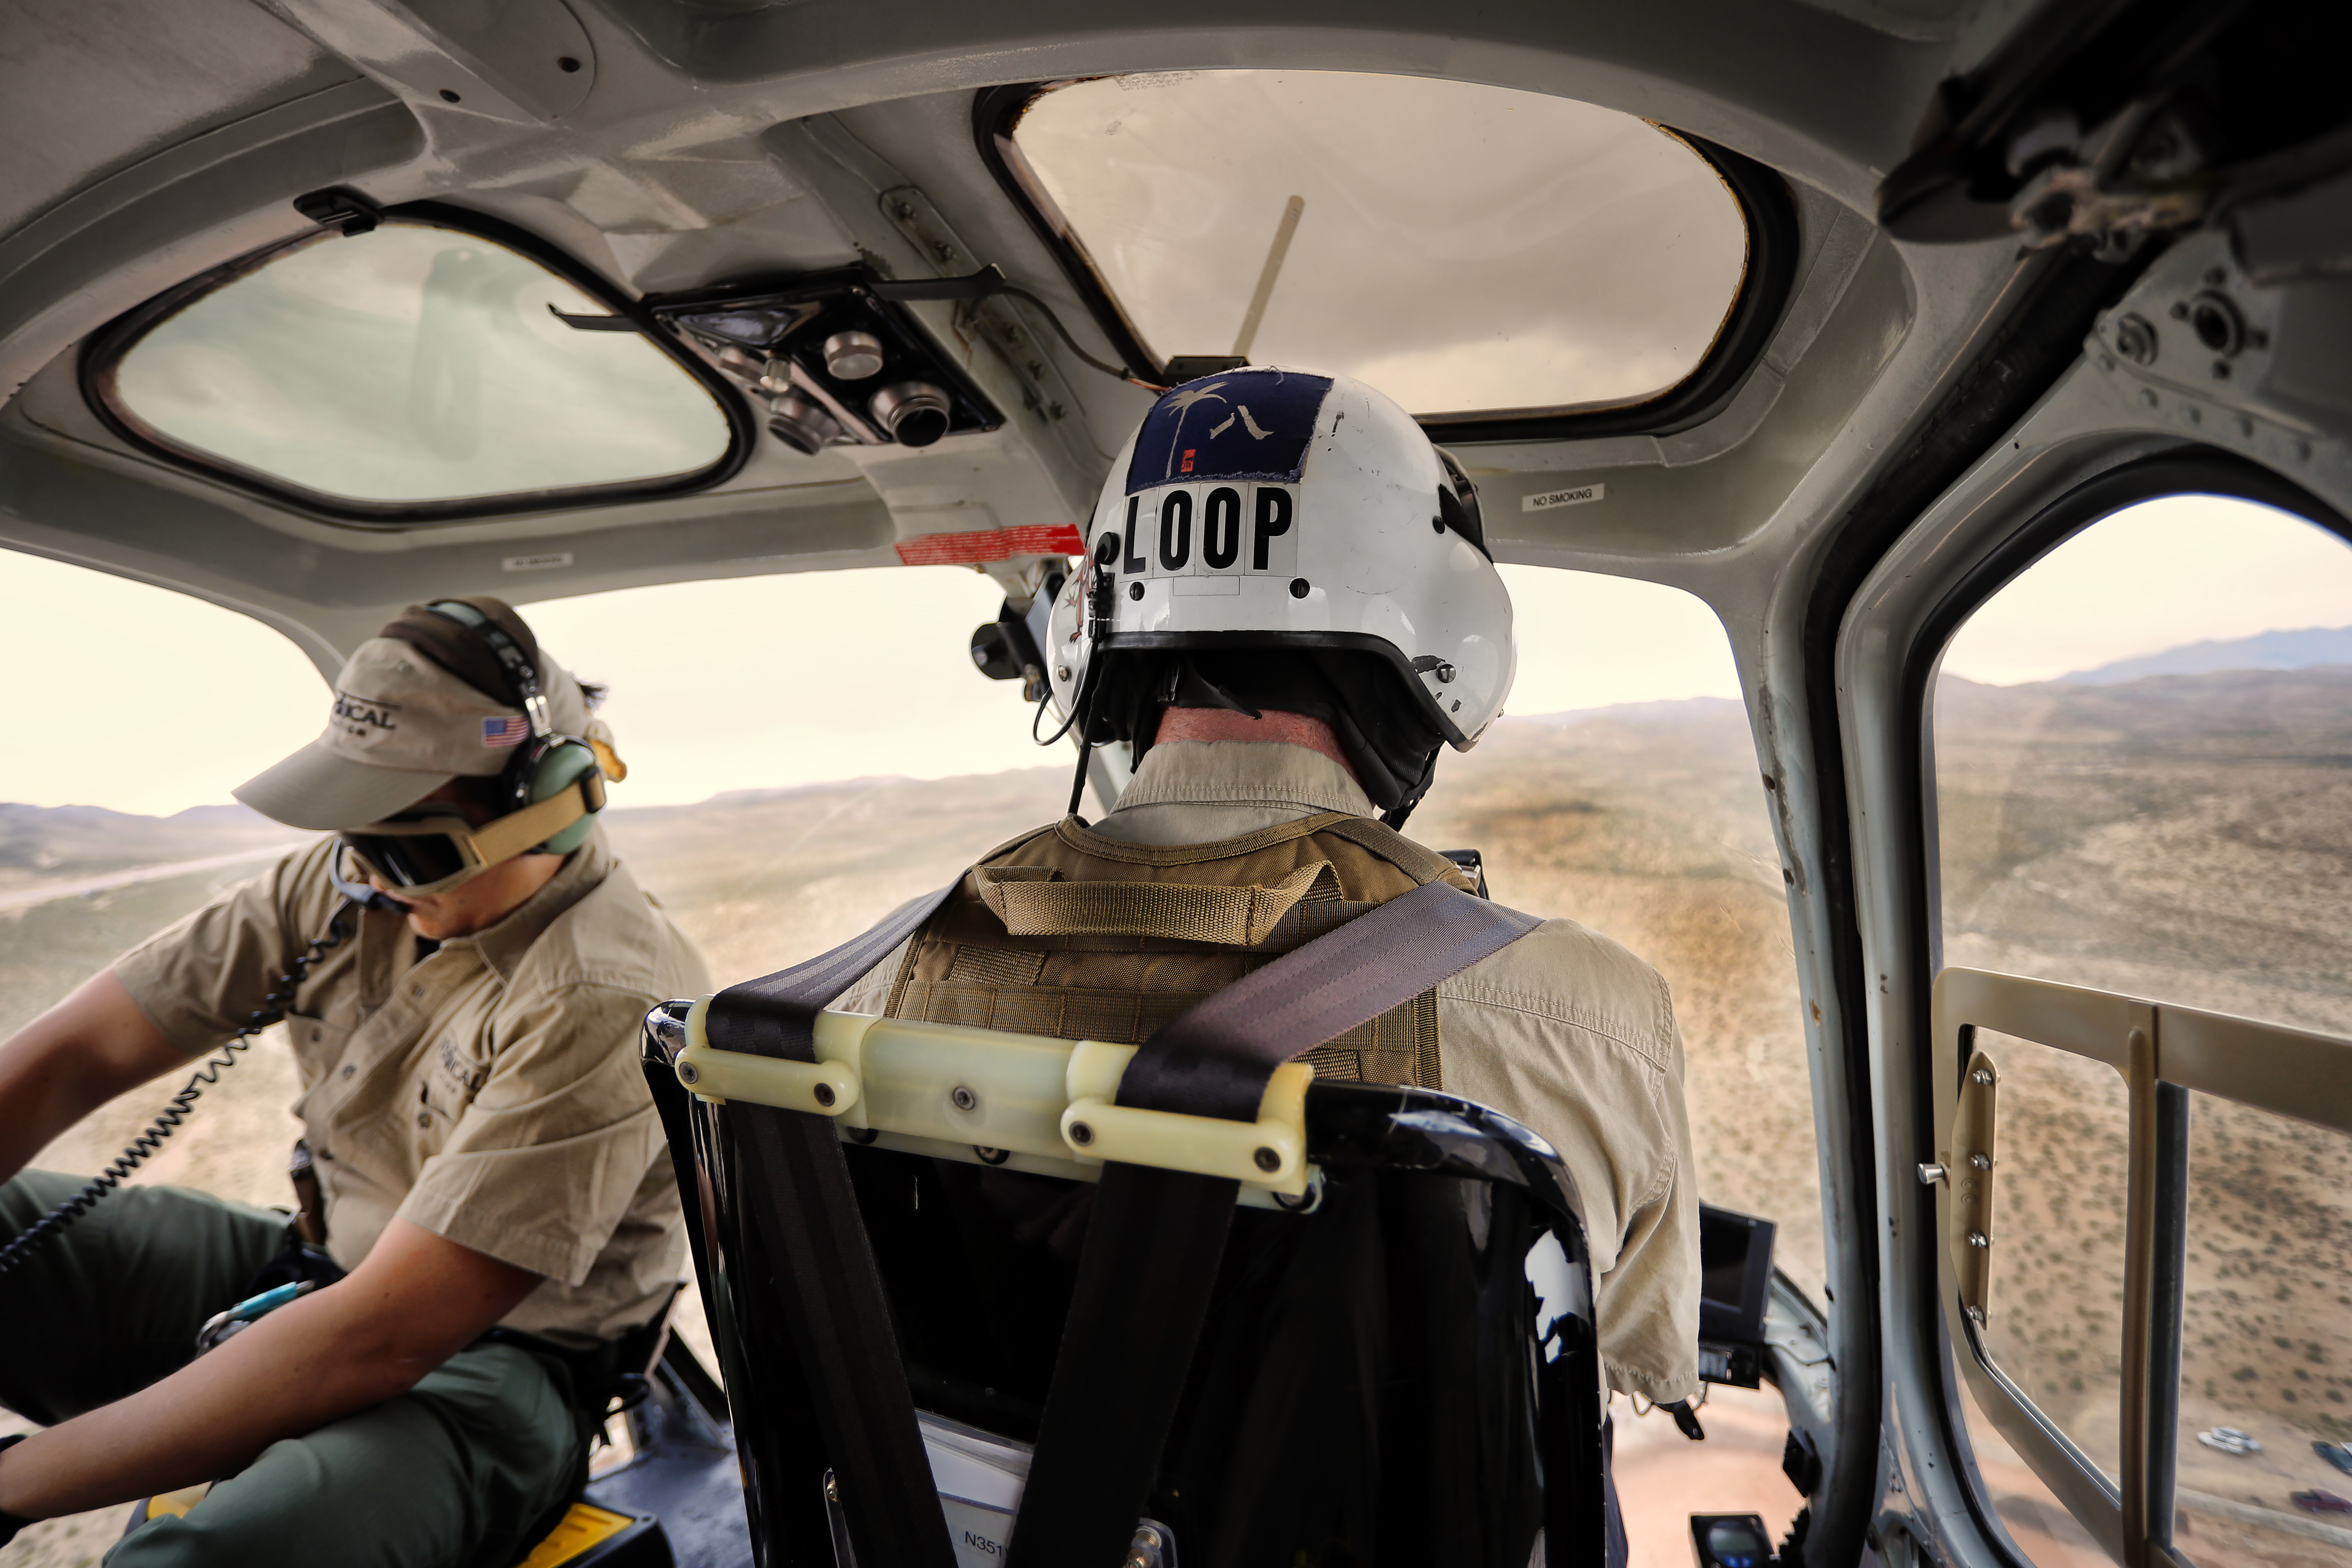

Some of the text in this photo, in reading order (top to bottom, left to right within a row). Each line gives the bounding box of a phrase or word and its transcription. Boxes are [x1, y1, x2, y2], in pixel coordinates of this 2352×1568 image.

[1533, 488, 1593, 506] NO SMOKING
[1123, 487, 1292, 575] LOOP
[965, 1531, 1008, 1557] N351
